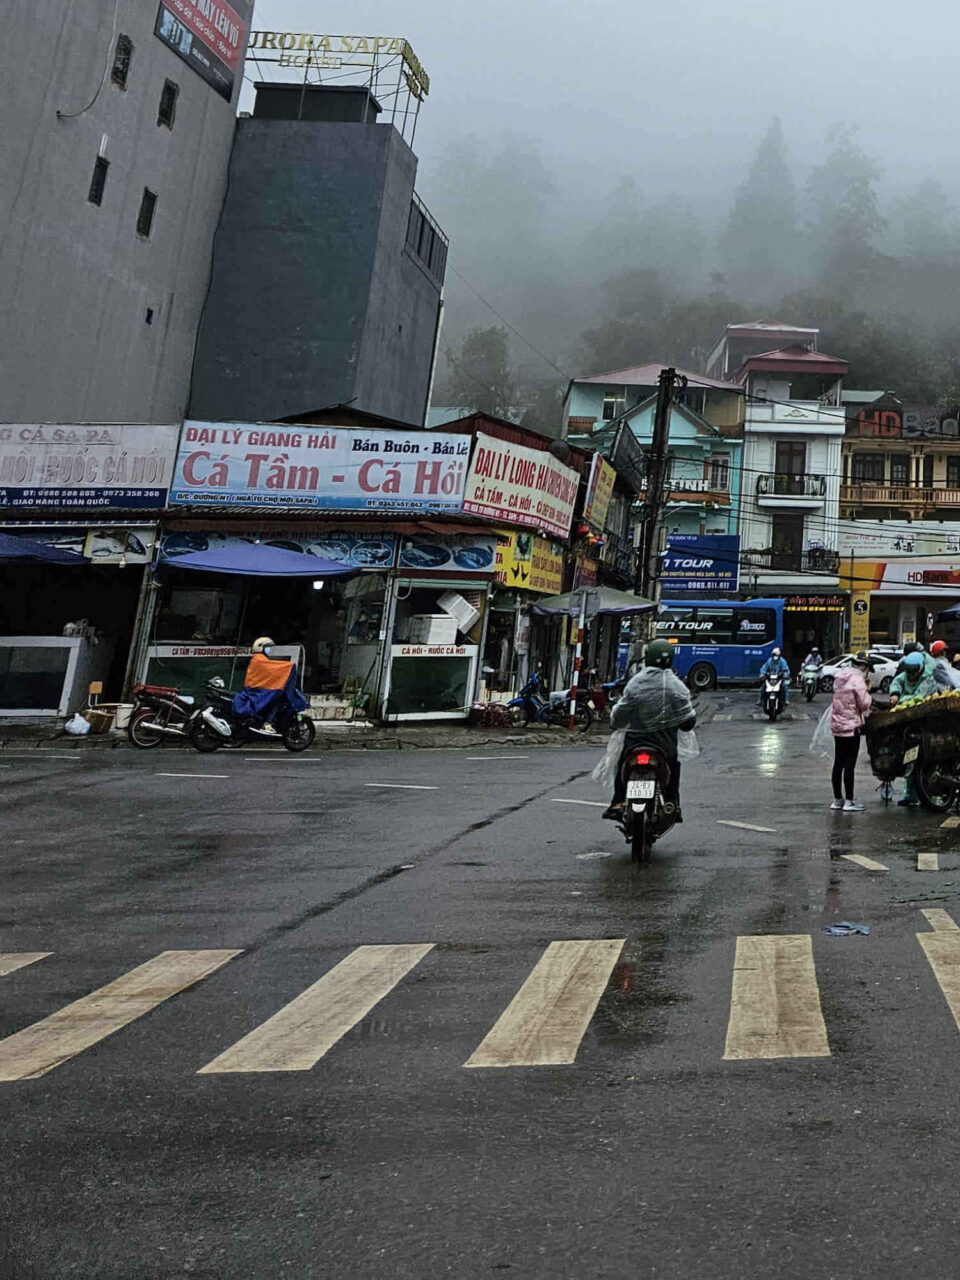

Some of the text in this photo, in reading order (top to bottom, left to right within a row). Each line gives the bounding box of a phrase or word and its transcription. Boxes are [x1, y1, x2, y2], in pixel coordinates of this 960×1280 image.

[340, 35, 402, 54] SAPA
[19, 425, 114, 443] CÁ SA PA
[185, 427, 337, 449] ĐẠI LÝ GIANG HẢI
[352, 439, 379, 452] Bán
[383, 440, 420, 454] Buôn
[431, 441, 454, 455] Bán
[103, 451, 128, 483] CÁ
[182, 451, 463, 495] Cá Tầm Cá Hồi
[474, 448, 496, 483] ĐẠI
[494, 449, 511, 481] LÝ
[509, 457, 537, 489] LONG
[474, 485, 486, 500] CÁ
[508, 492, 519, 508] CÁ
[674, 559, 714, 568] TOUR
[678, 621, 714, 630] TOUR
